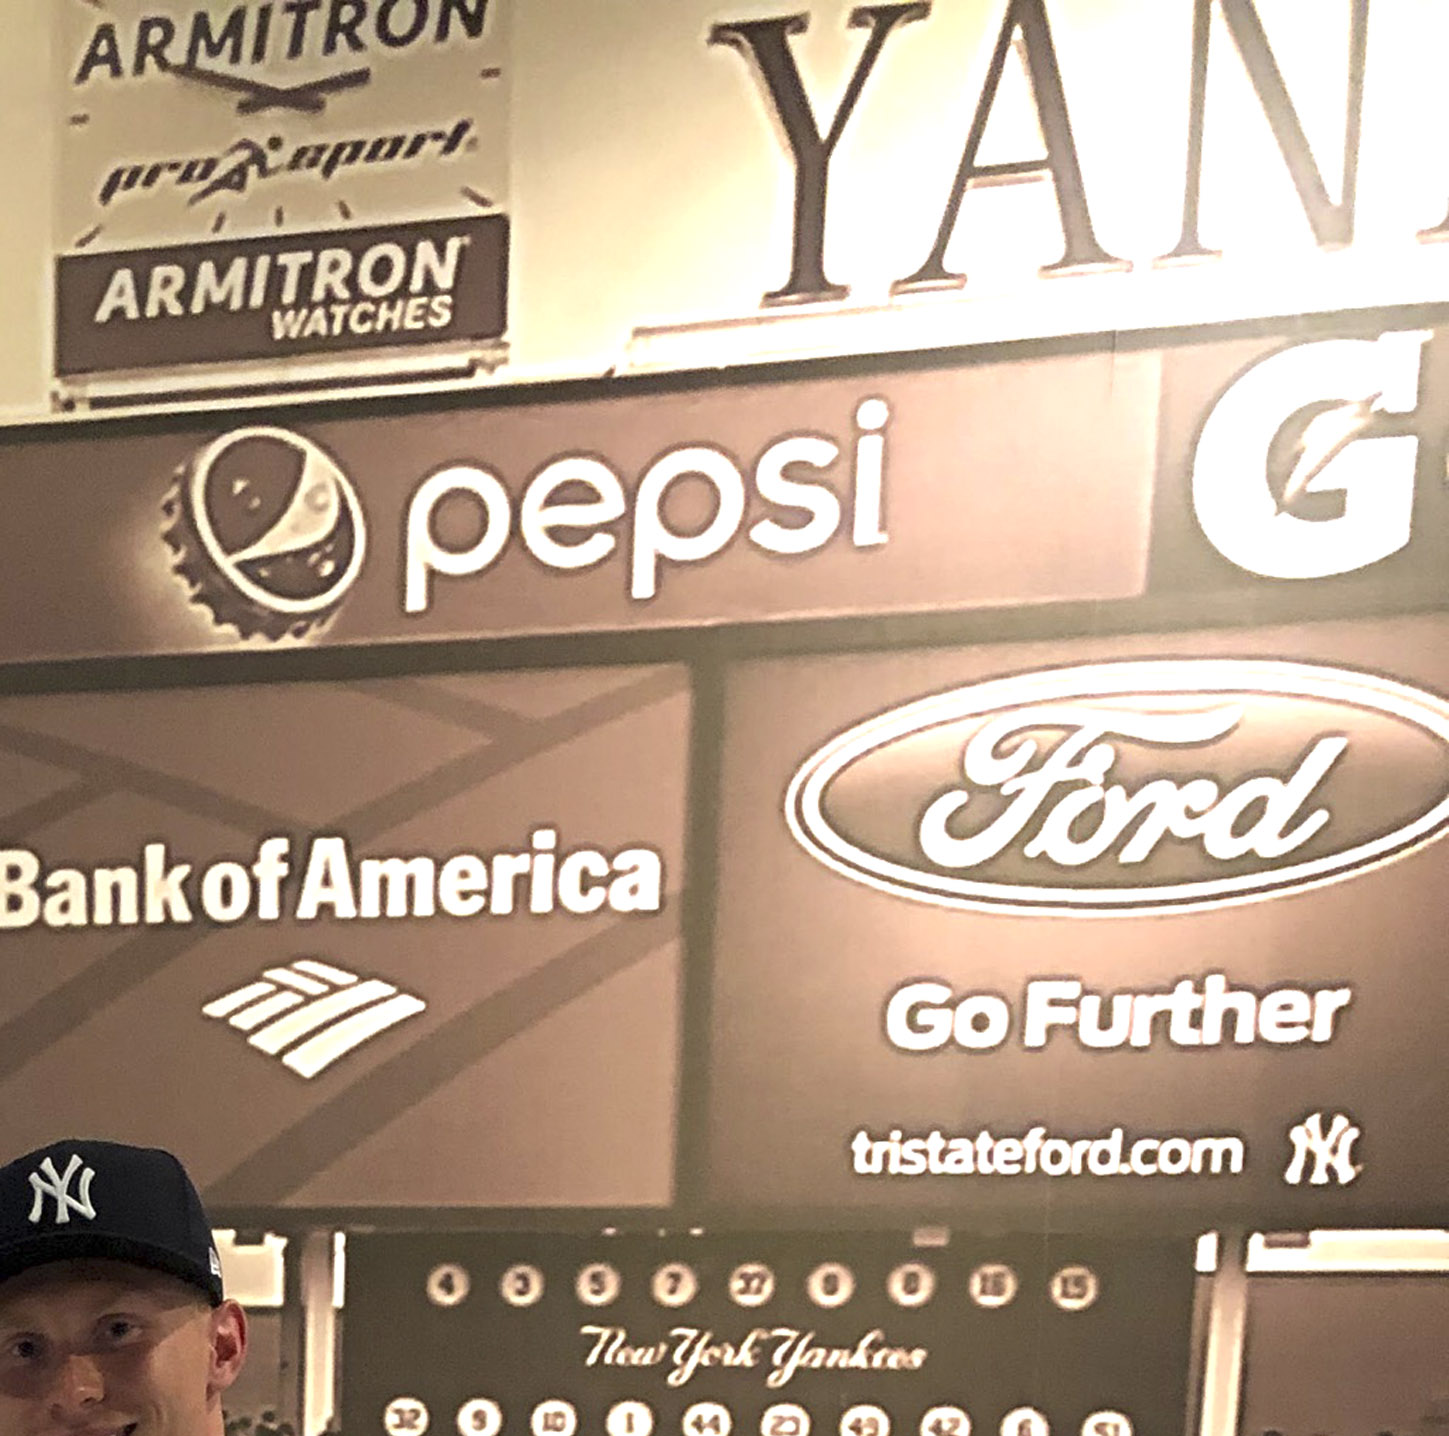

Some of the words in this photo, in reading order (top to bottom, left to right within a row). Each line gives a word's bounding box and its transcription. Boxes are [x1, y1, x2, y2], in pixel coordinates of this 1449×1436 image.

[74, 0, 489, 86] ARMITRON
[707, 0, 1449, 309] YAN
[95, 236, 461, 324] ARMITRON
[271, 294, 453, 341] WATCHES
[404, 397, 891, 614] pepsi
[919, 702, 1350, 868] Ford
[201, 837, 290, 923] of
[296, 828, 662, 920] America
[885, 982, 1010, 1051] Go
[1024, 974, 1352, 1048] Further
[27, 1153, 97, 1224] NY
[851, 1126, 1245, 1177] tristateford.com
[580, 1325, 669, 1367] New
[666, 1327, 771, 1388] York
[766, 1328, 928, 1388] Yankees
[689, 1413, 722, 1435] 44
